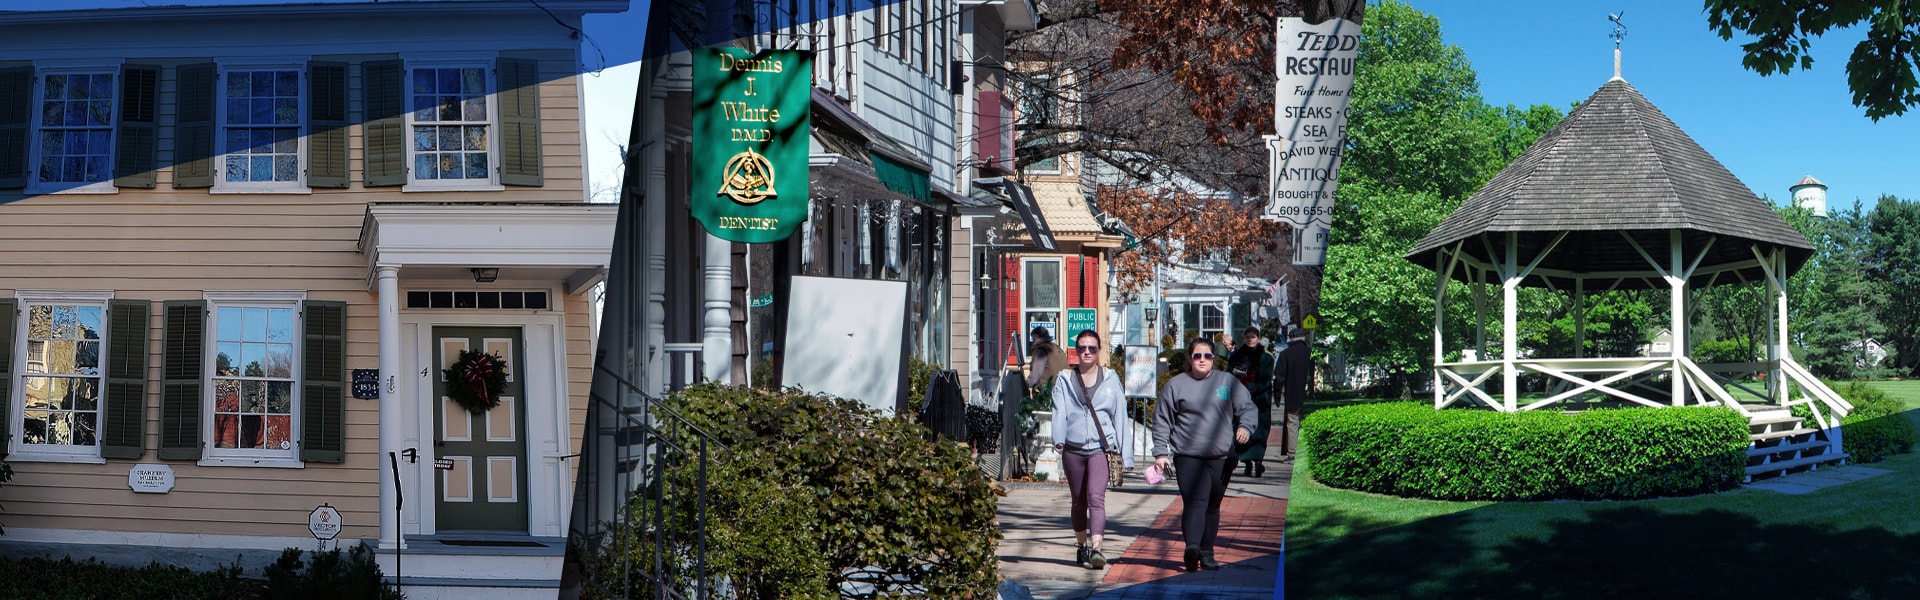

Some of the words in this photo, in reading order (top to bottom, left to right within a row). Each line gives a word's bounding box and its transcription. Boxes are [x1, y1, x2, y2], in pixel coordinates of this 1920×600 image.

[719, 53, 783, 73] Dennis
[744, 77, 757, 96] J.
[1294, 85, 1314, 96] Fine
[1318, 85, 1344, 97] Home
[720, 101, 780, 122] White
[1285, 106, 1332, 118] STEAKS
[1303, 124, 1328, 138] SEA
[1280, 146, 1315, 161] DAVID
[1278, 190, 1319, 199] BOUGHT
[1321, 190, 1329, 199] &
[1280, 206, 1300, 216] 609
[719, 216, 779, 230] DENTIST
[1068, 312, 1095, 321] PUBLIC
[1068, 322, 1095, 331] PARKING
[420, 367, 428, 378] 4
